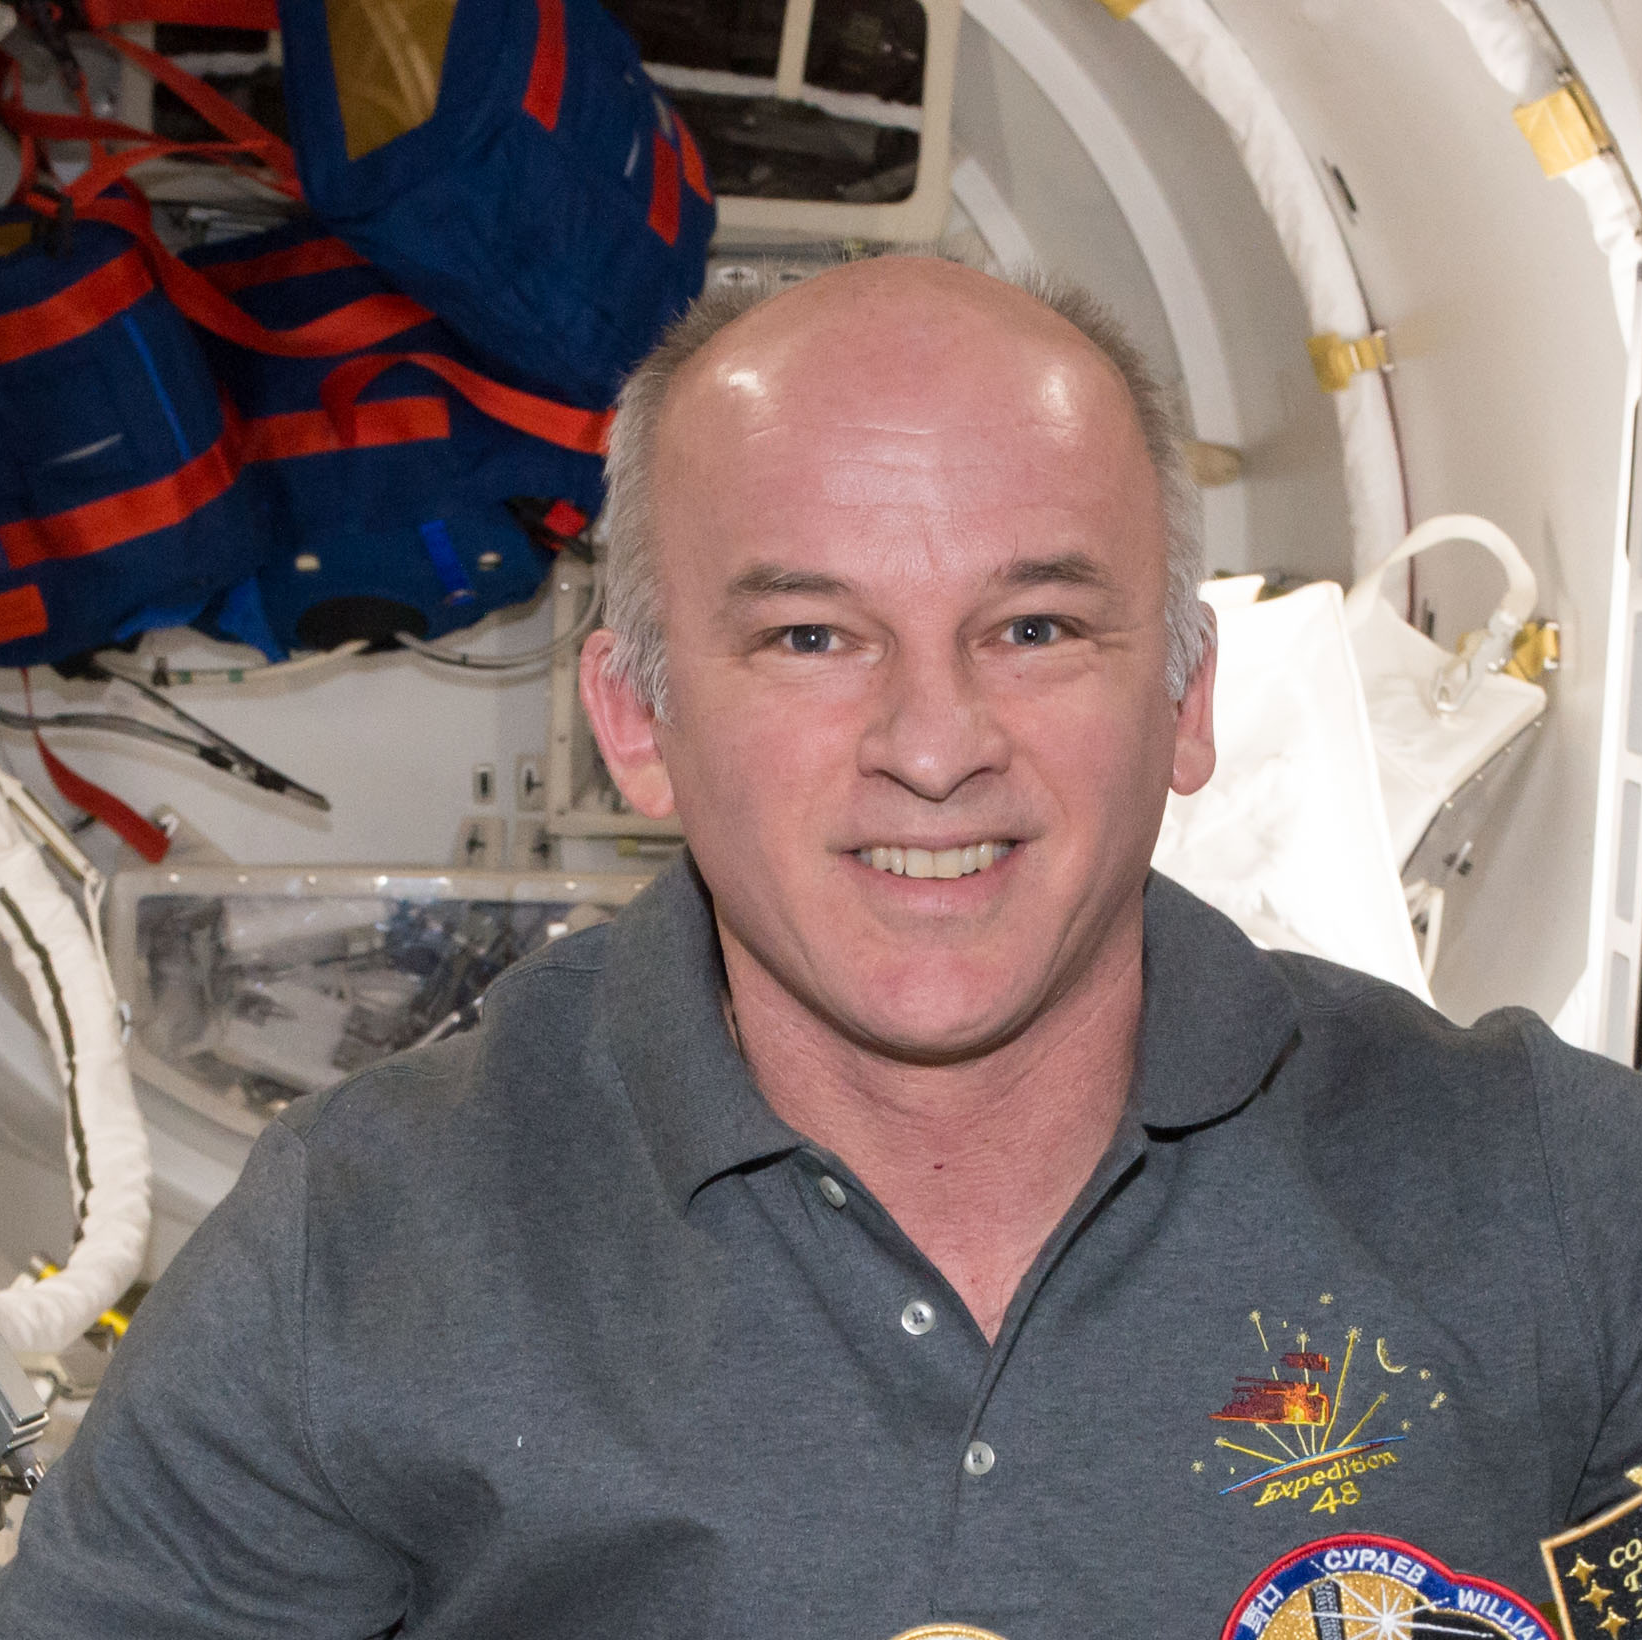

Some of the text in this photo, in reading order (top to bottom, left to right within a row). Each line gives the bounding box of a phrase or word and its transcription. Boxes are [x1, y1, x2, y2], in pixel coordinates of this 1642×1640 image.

[1253, 1451, 1398, 1507] Expedition
[1309, 1482, 1362, 1515] 48
[1324, 1547, 1428, 1586] СУРАЕВ
